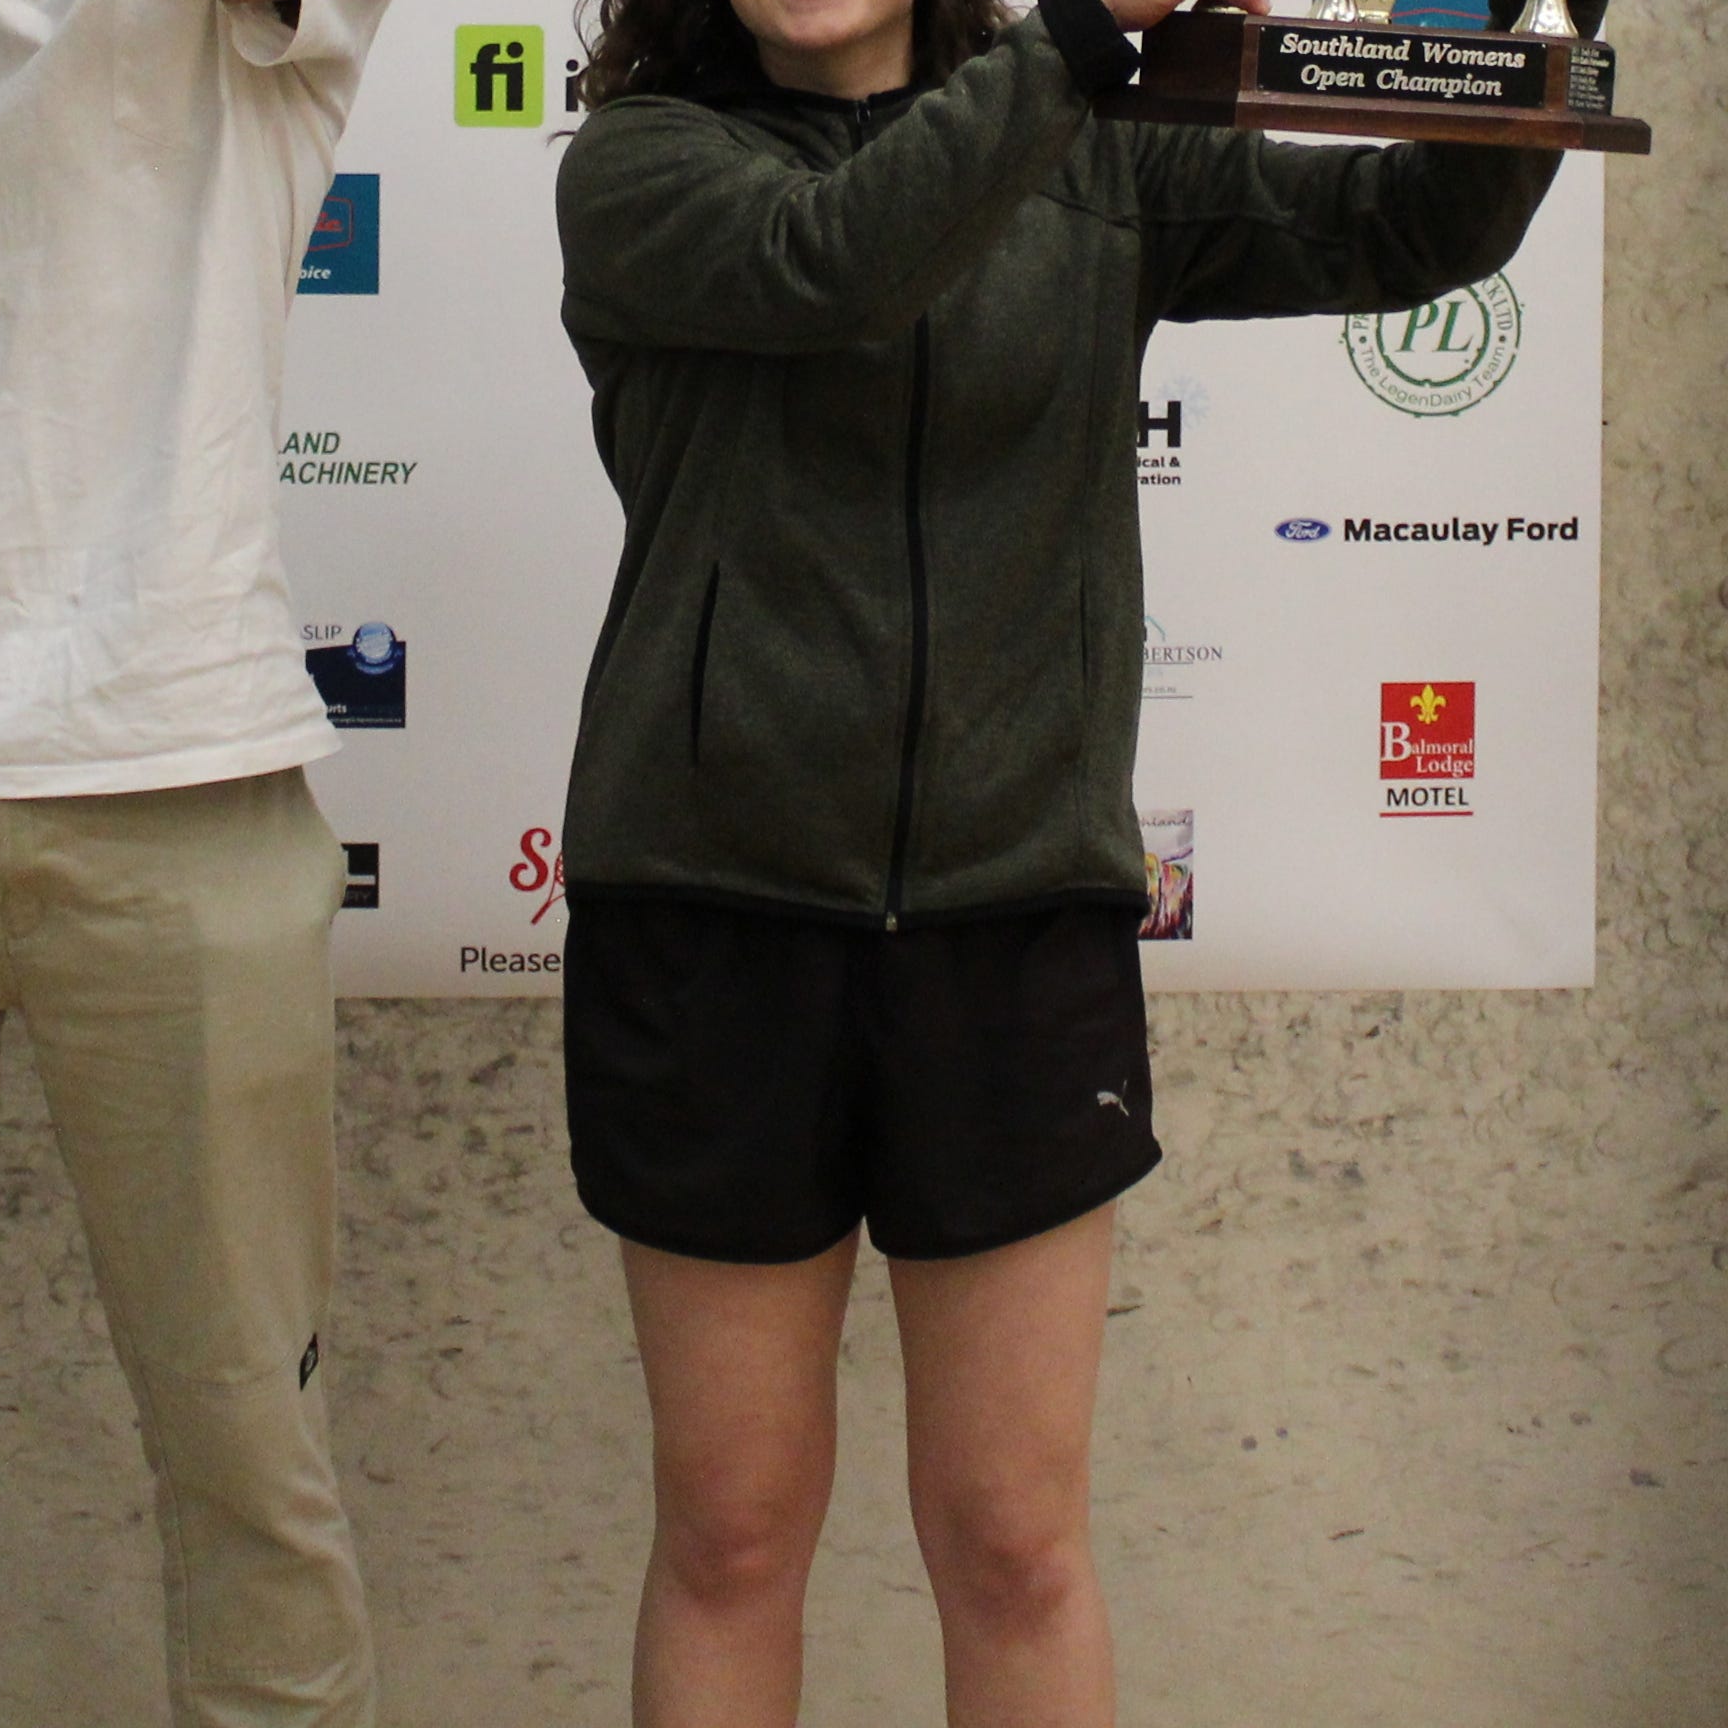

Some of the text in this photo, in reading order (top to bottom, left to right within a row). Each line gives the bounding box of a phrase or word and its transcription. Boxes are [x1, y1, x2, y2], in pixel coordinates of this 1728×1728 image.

[1280, 33, 1525, 68] Southland Womens
[470, 42, 524, 112] fi
[1301, 64, 1502, 99] Open Champion
[1379, 377, 1472, 407] LegenDairy
[1473, 347, 1505, 388] Team
[1343, 518, 1498, 545] Macaulay
[1506, 517, 1578, 541] Ford
[1381, 722, 1473, 762] Balmoral
[1416, 755, 1473, 777] Lodge
[1387, 787, 1469, 806] MOTEL
[460, 947, 561, 973] Please
